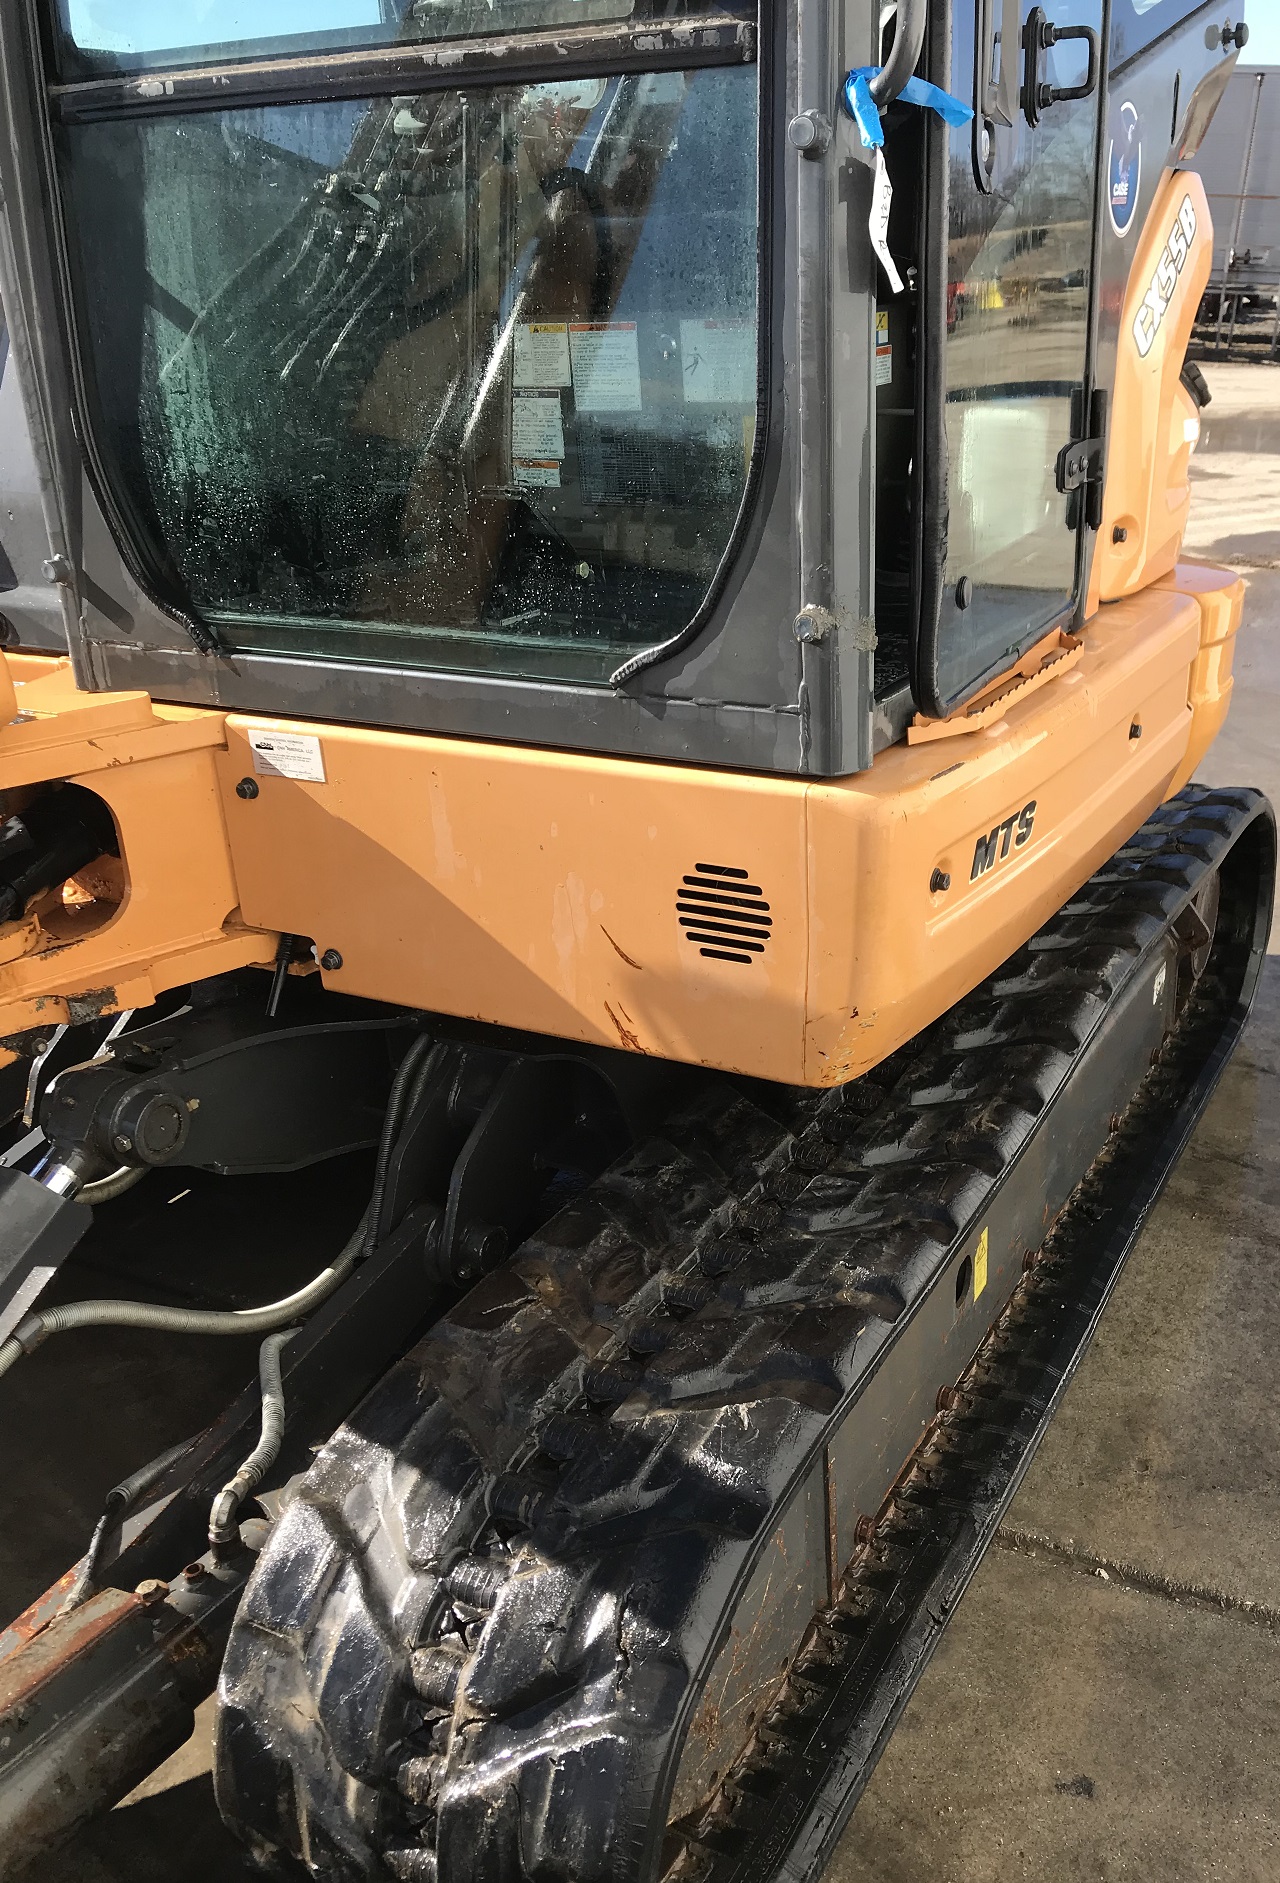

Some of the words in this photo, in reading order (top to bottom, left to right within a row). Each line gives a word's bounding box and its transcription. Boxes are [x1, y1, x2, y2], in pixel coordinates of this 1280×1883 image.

[1113, 183, 1128, 197] CASE
[1132, 193, 1198, 359] CX55B
[968, 800, 1037, 885] MTS
